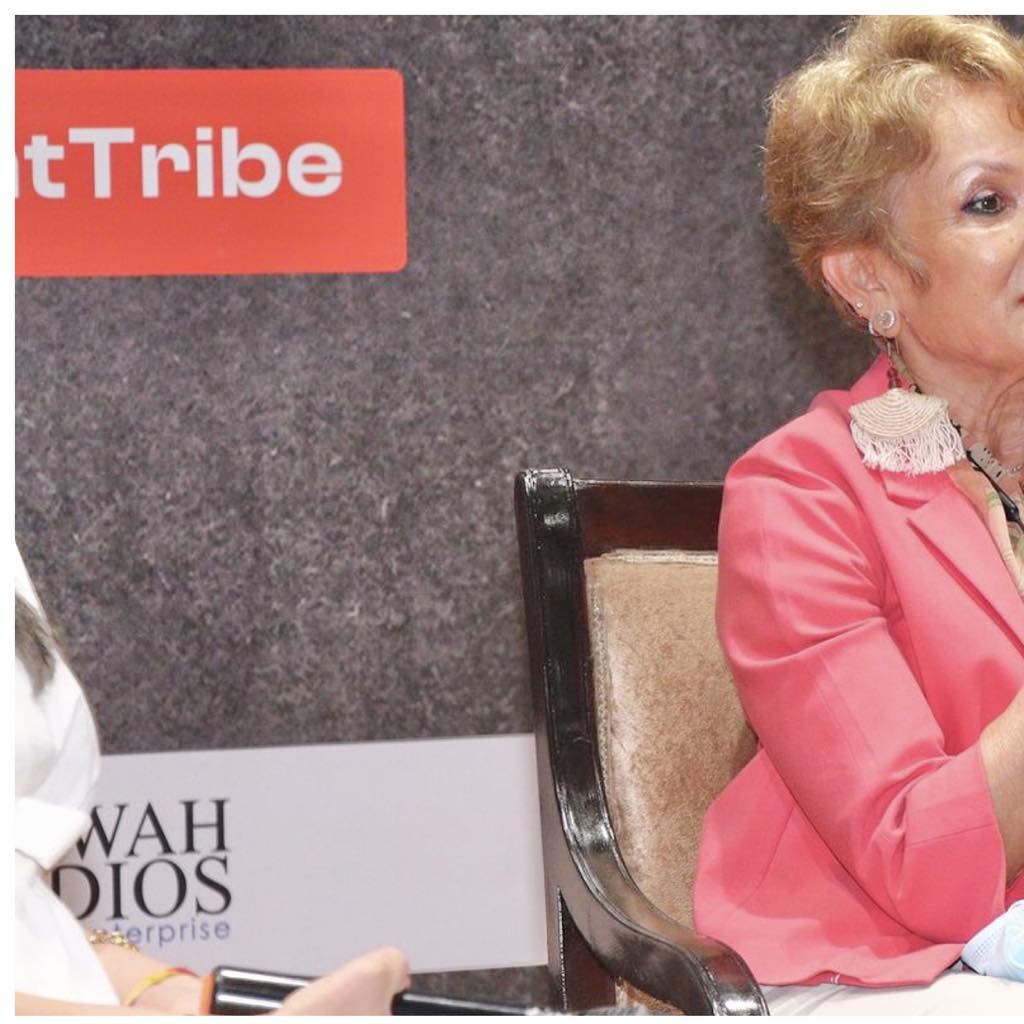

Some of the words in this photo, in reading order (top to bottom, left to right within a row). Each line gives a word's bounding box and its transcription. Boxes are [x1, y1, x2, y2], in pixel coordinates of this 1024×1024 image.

[15, 127, 343, 199] tTribe
[76, 797, 232, 861] WAH
[51, 856, 232, 920] DIOS
[113, 919, 231, 948] erprise
